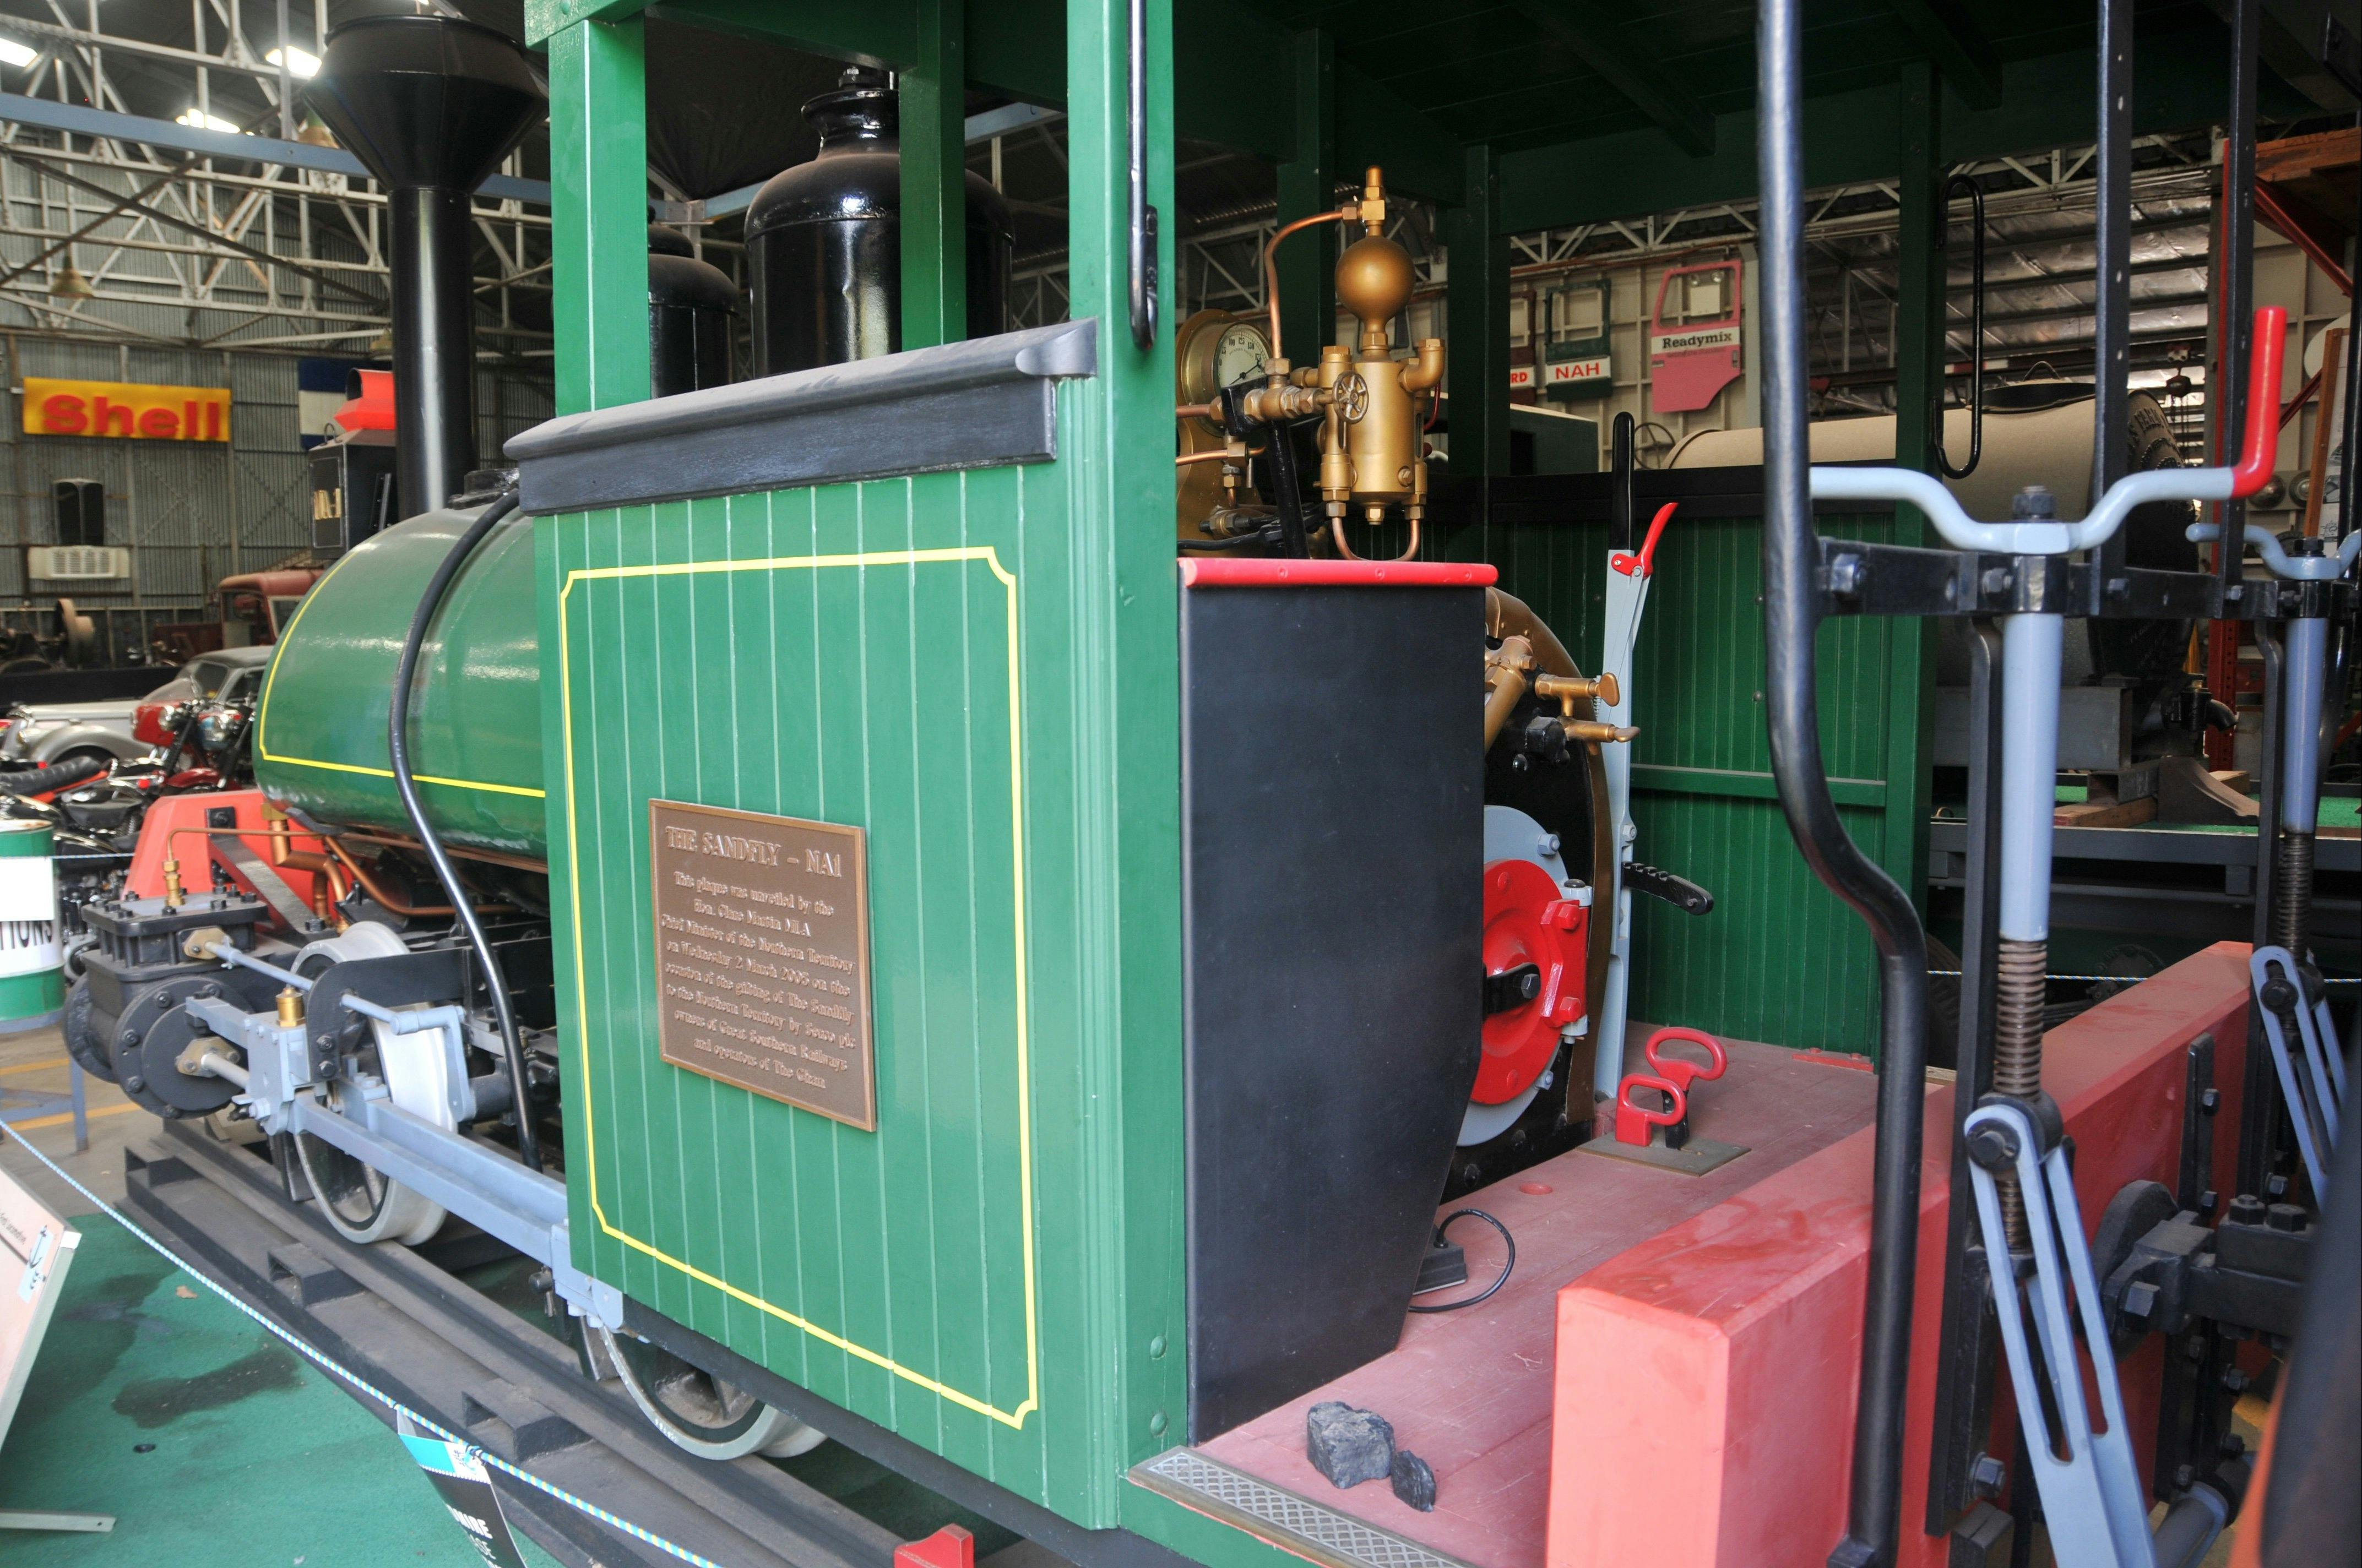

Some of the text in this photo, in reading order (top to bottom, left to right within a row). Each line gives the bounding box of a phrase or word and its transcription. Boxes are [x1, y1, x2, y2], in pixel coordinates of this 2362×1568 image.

[1663, 332, 1732, 349] Readymix
[1555, 362, 1600, 380] NAH
[42, 395, 220, 439] Shell
[666, 826, 697, 852] THE
[702, 831, 781, 867] SANDFLY
[805, 848, 841, 877] NA1
[675, 871, 833, 916] This plaque was unveiled by the
[661, 913, 855, 975] Chief Minister of the Northern Territory
[747, 910, 781, 929] Martin
[665, 962, 702, 981] occasion
[704, 970, 714, 985] of
[716, 974, 733, 990] the
[773, 988, 784, 1004] of
[788, 993, 807, 1010] The
[811, 999, 855, 1025] Sandfly
[666, 940, 678, 952] on
[682, 941, 731, 968] Wednesday
[736, 955, 742, 968] 2
[746, 958, 777, 977] March
[812, 977, 827, 990] on
[830, 979, 850, 997] the
[666, 983, 676, 996] to
[678, 986, 693, 1001] the
[696, 990, 738, 1015] Northern
[741, 1004, 785, 1030] Territory
[790, 1017, 801, 1035] by
[694, 1035, 826, 1088] and operators of The Ghan
[707, 1016, 717, 1031] of
[720, 1020, 746, 1040] Great
[750, 1029, 796, 1055] Southern
[801, 1044, 847, 1073] Railways
